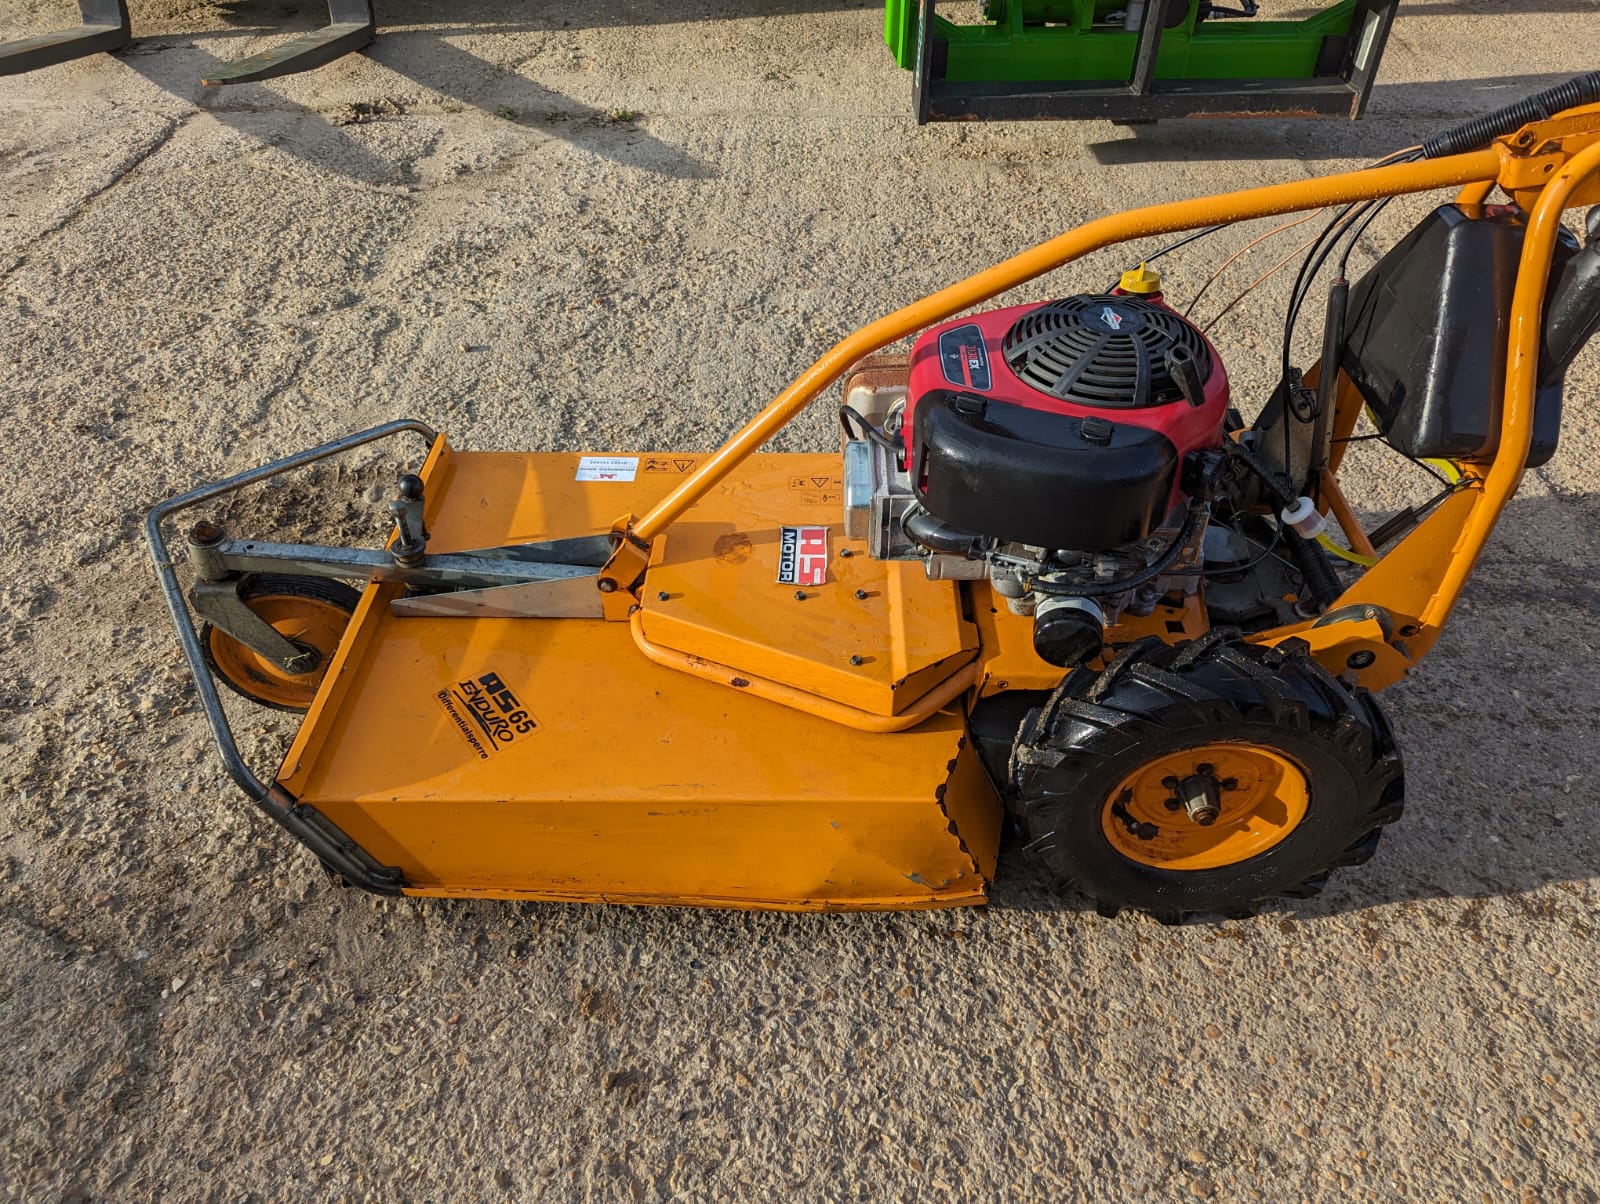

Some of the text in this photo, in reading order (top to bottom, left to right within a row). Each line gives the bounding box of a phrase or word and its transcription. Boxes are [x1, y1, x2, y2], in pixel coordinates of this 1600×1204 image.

[781, 532, 795, 581] MOTOR
[438, 690, 488, 759] Differentialsperre
[458, 680, 514, 742] ENDURO
